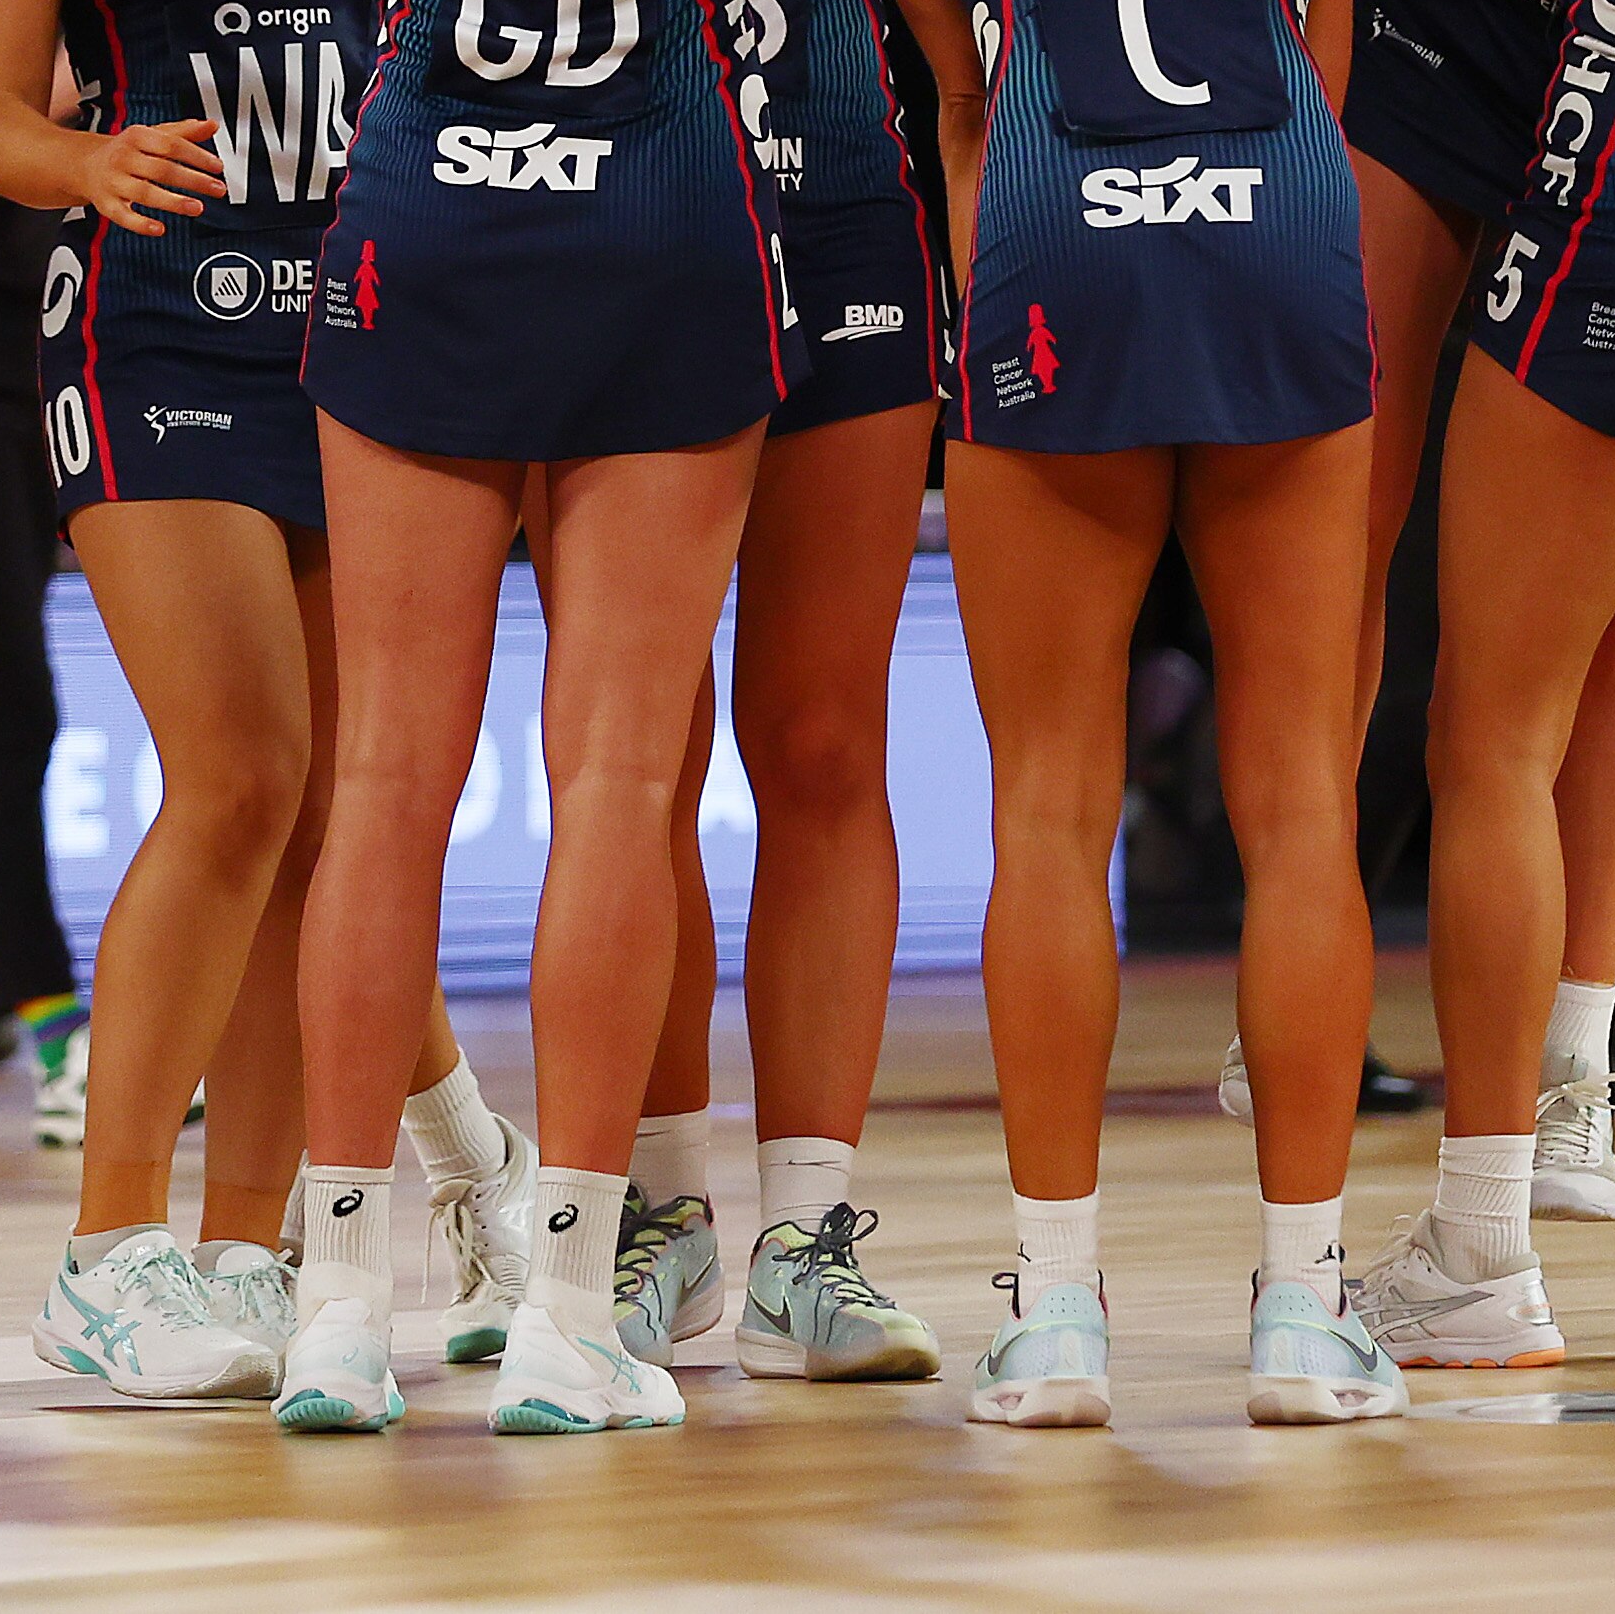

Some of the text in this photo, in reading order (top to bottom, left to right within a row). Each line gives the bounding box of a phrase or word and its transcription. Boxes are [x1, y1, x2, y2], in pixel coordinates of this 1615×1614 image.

[257, 8, 331, 34] origin
[188, 41, 355, 204] WA
[1487, 231, 1539, 322] 5
[845, 305, 904, 326] BMD
[992, 357, 1020, 373] Breast
[994, 368, 1024, 385] Cancer
[996, 378, 1034, 396] Network
[998, 391, 1036, 409] Australia
[166, 410, 232, 425] VICTORIAN
[44, 385, 91, 488] 10
